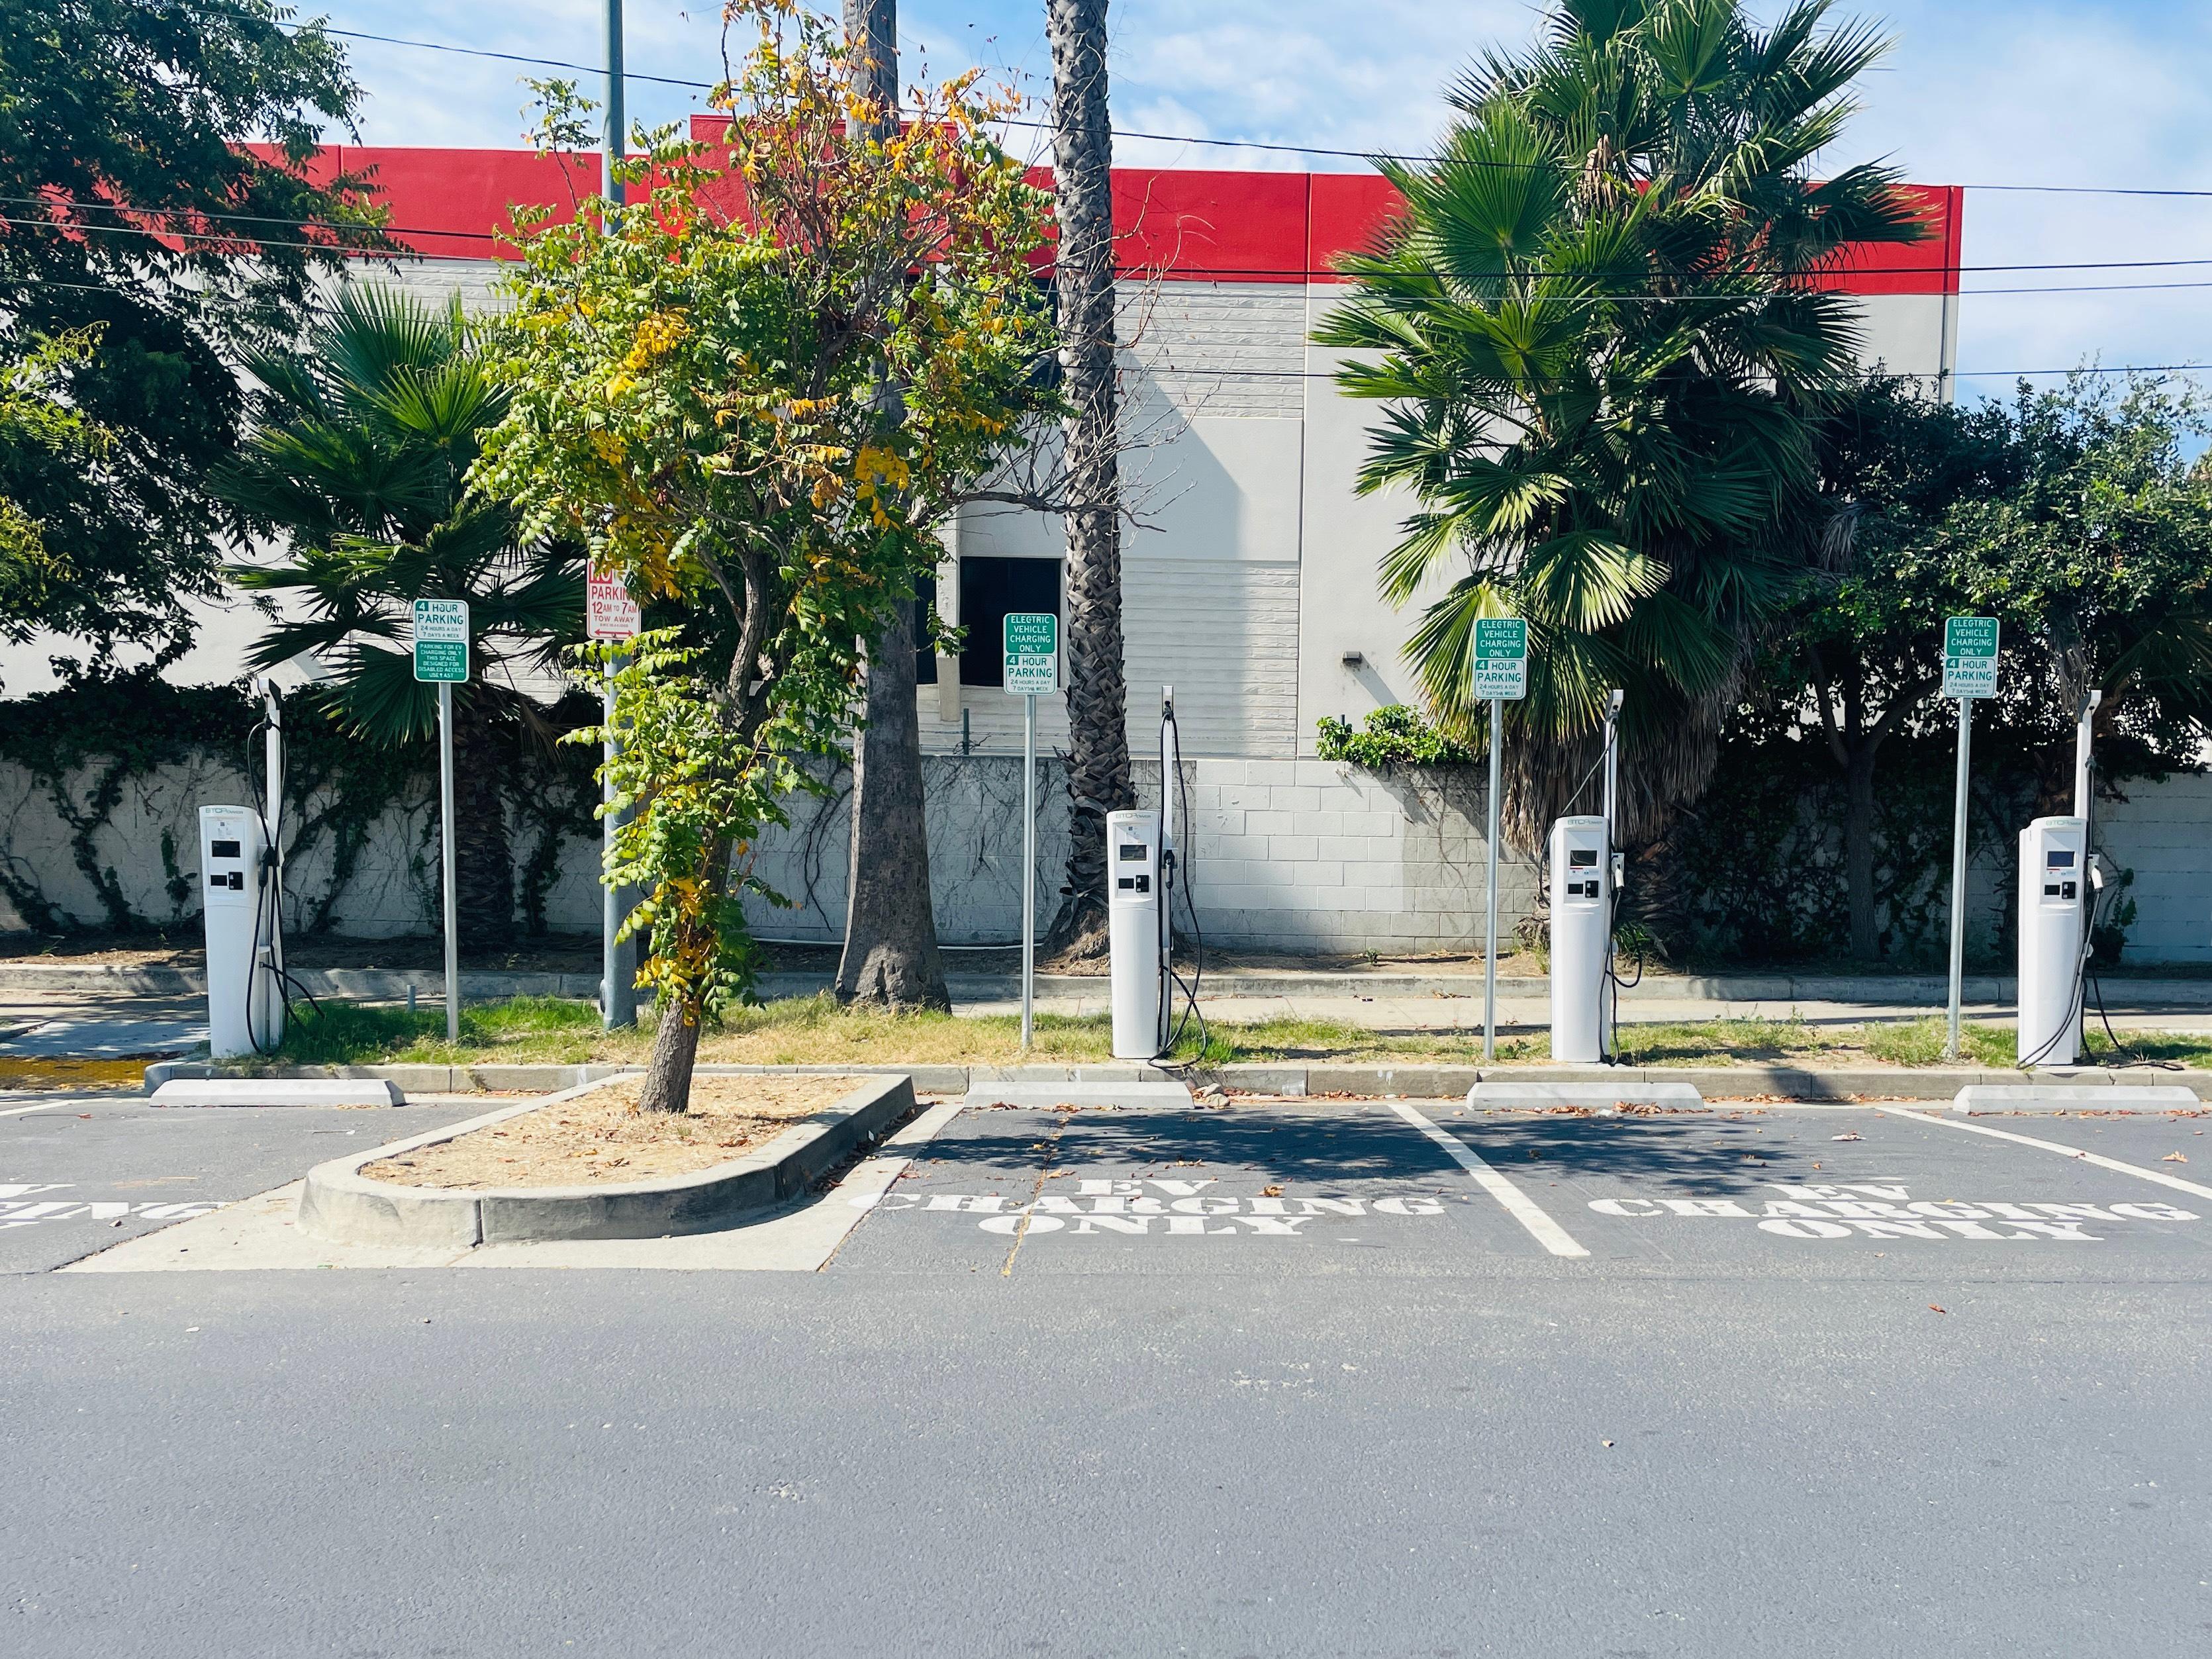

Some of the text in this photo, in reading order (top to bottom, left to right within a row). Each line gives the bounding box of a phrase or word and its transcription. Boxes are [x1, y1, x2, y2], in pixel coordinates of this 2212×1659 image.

[418, 614, 463, 624] PARKING
[1009, 668, 1052, 677] PARKING
[1478, 673, 1521, 682] PARKING
[1948, 671, 1992, 681] PARKING
[1077, 1179, 1224, 1196] EV
[1764, 1183, 1912, 1201] EV
[848, 1192, 1445, 1215] CHARGING
[1586, 1198, 2201, 1221] CHARGING
[978, 1215, 1314, 1236] ONLY
[1757, 1219, 2106, 1241] ONLY
